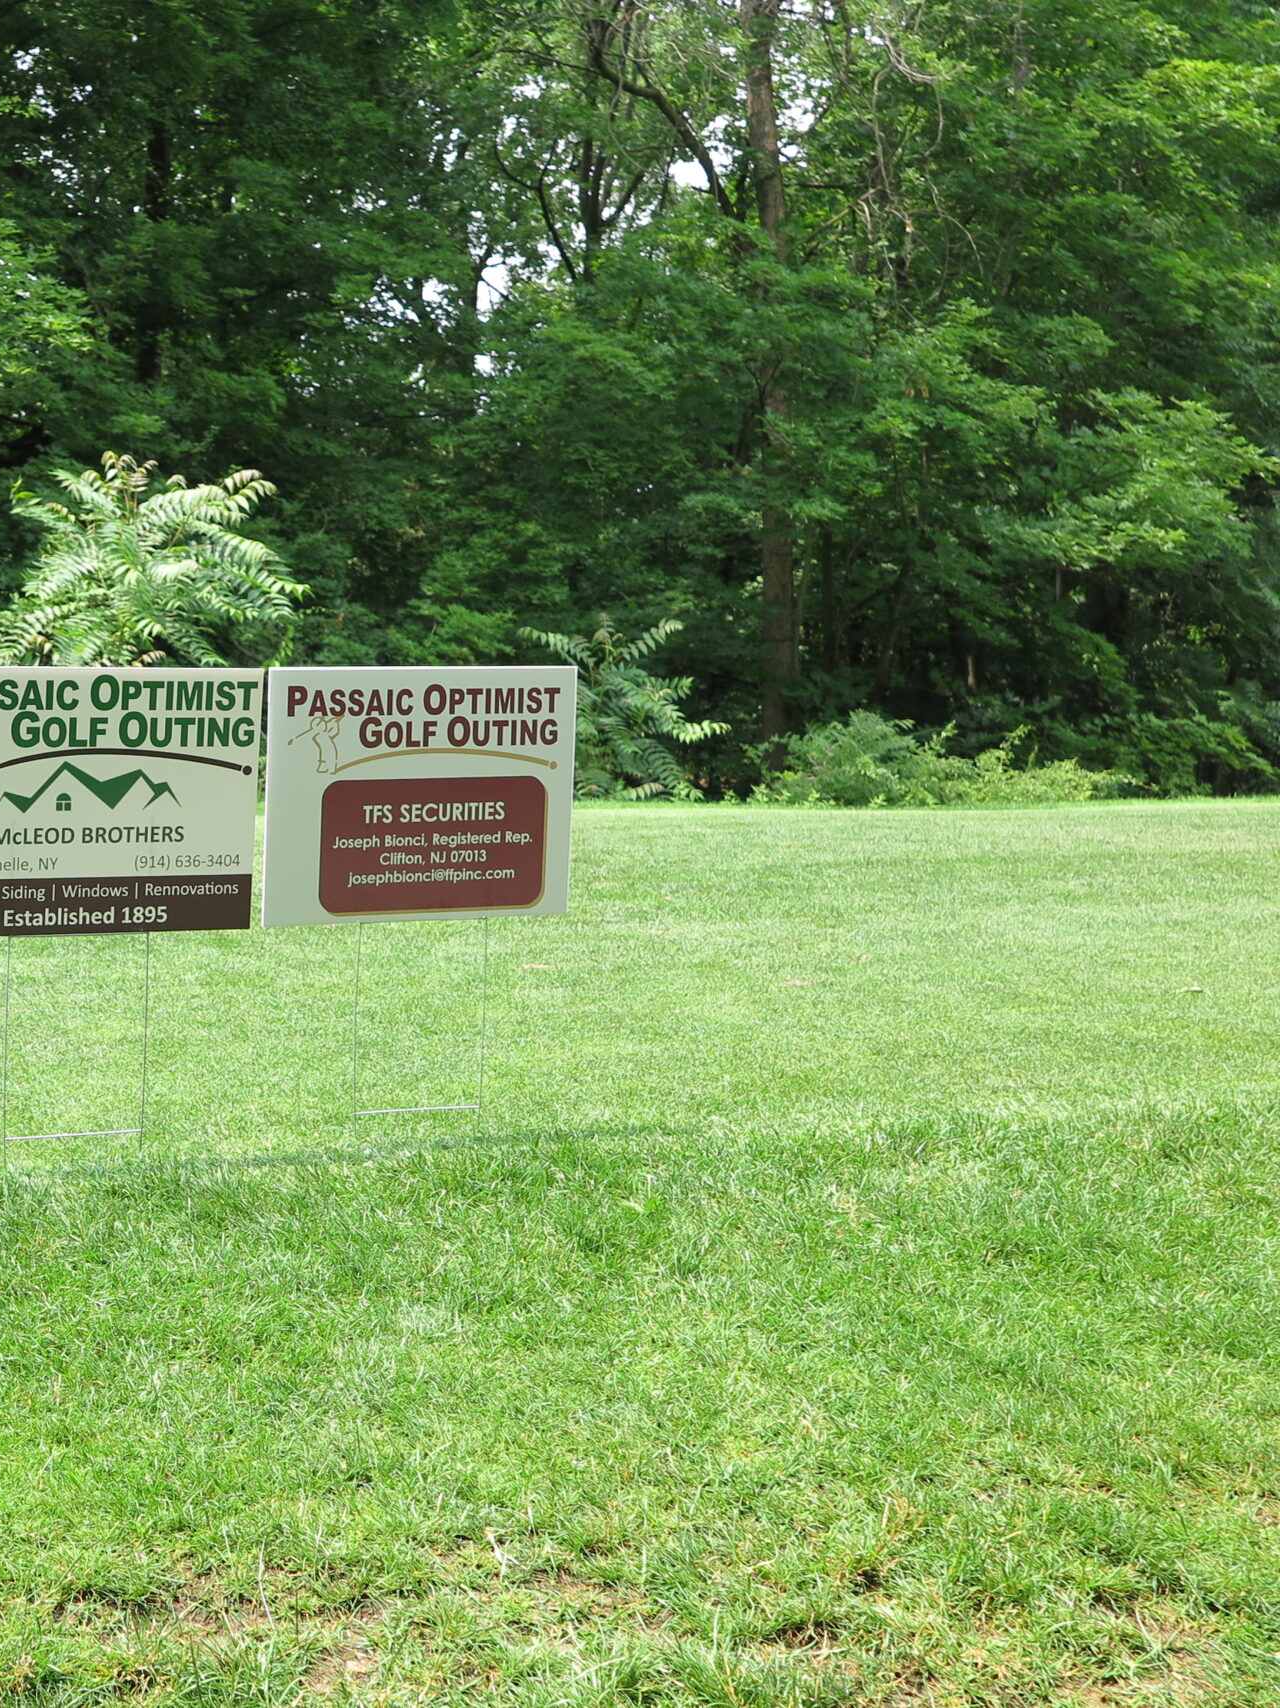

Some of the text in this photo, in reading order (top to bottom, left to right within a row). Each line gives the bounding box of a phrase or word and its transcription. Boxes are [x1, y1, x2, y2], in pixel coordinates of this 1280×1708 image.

[91, 675, 258, 711] OPTIMIST
[287, 684, 560, 717] PASSAIC OPTIMIST
[11, 711, 255, 747] GOLF OUTING
[359, 716, 558, 748] GOLF OUTING
[363, 802, 505, 824] TFS SECURITIES
[82, 825, 184, 844] BROTHERS
[333, 831, 532, 851] Joseph Bionci, Registered Rep.
[38, 857, 58, 870] NY
[134, 854, 240, 870] (914) 636-3404
[380, 850, 487, 866] Clifton, NJ 07013
[348, 868, 515, 887] josephbionci@ffpinc.com
[1, 886, 45, 901] Siding
[62, 885, 128, 898] Windows
[145, 882, 238, 897] Rennovations
[3, 906, 167, 927] Established 1895
